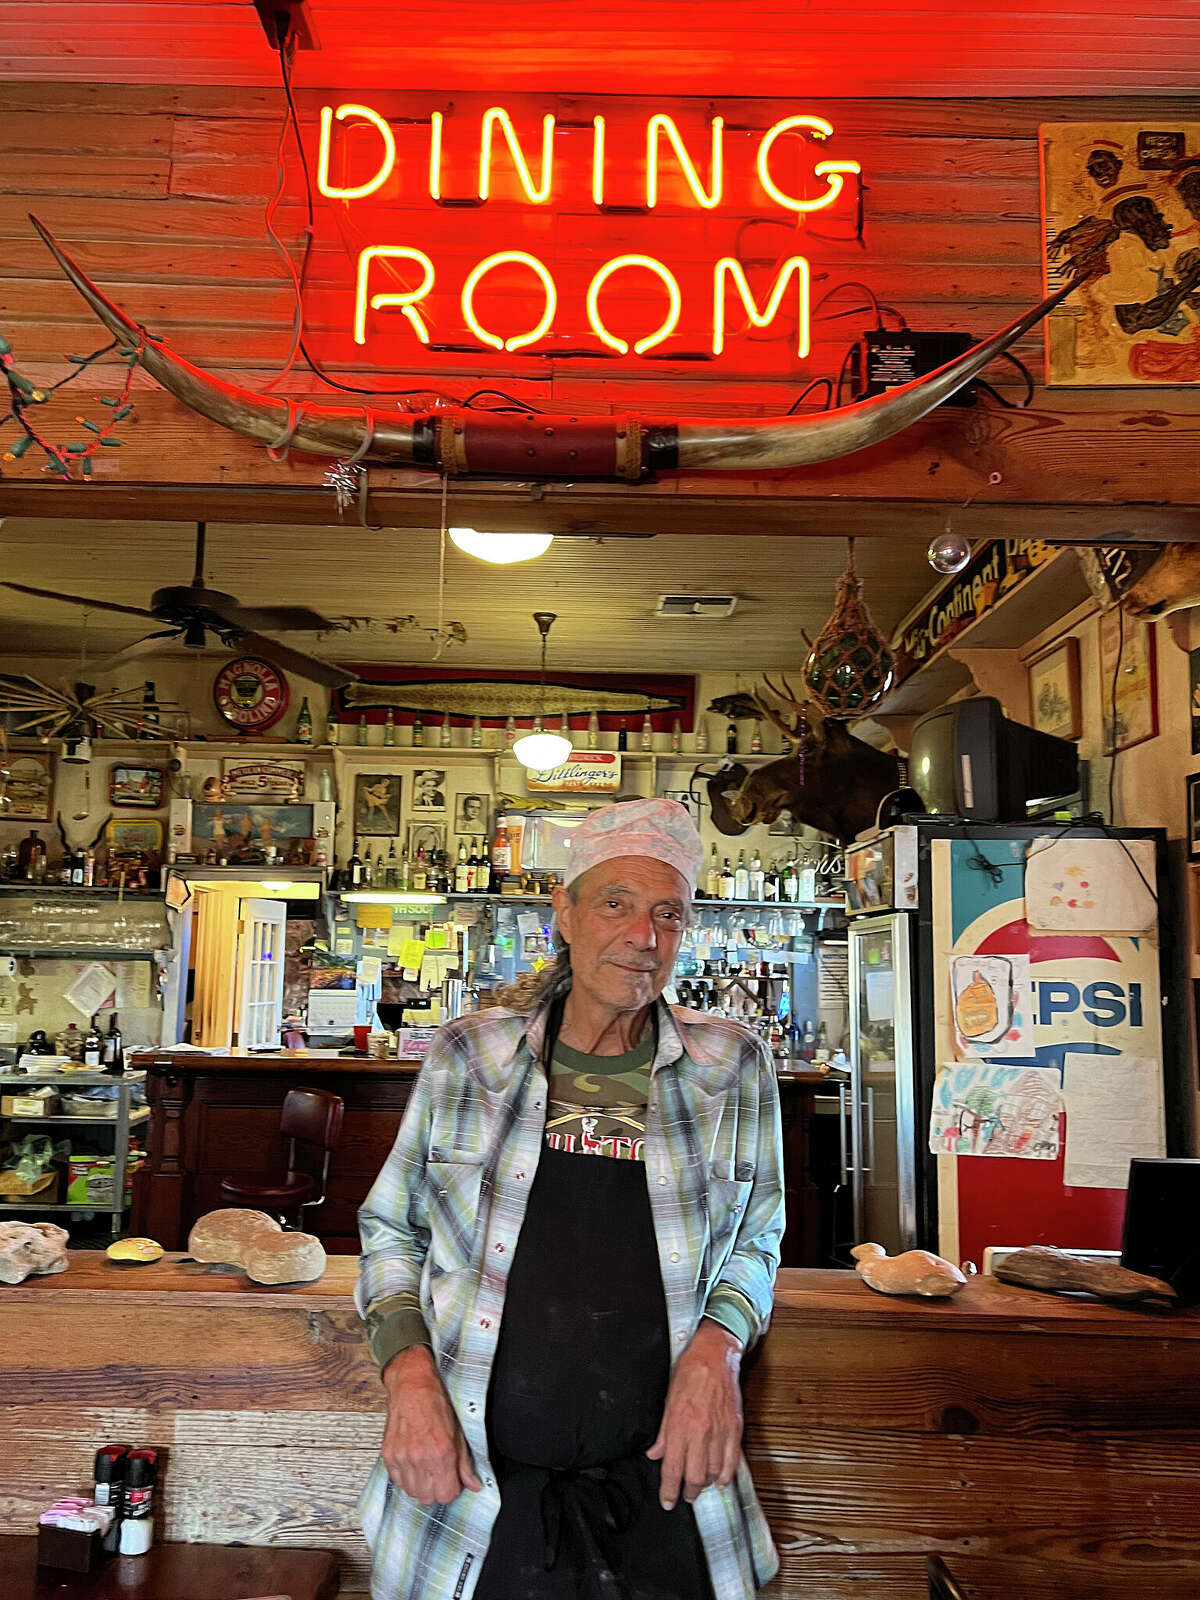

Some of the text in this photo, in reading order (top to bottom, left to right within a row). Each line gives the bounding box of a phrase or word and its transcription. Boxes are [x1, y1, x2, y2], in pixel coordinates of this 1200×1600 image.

[316, 103, 861, 213] DINING
[353, 244, 812, 360] ROOM
[1032, 981, 1142, 1028] PSI
